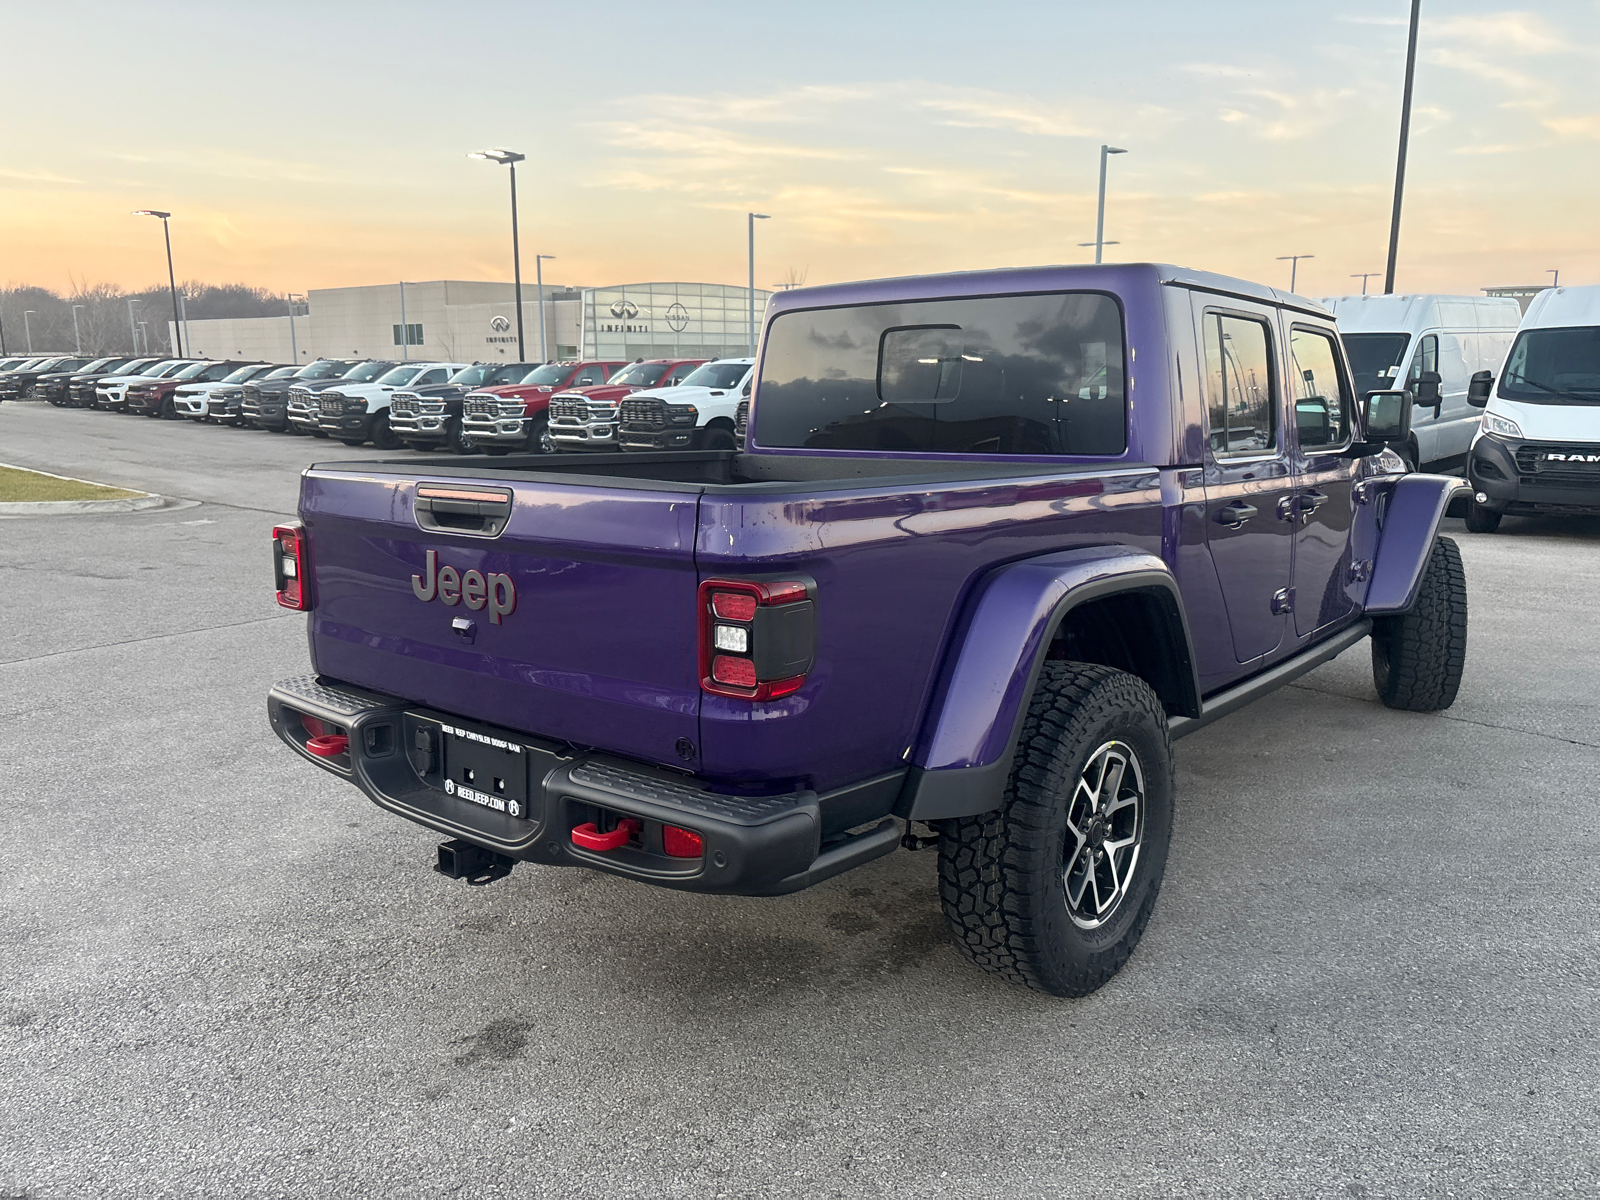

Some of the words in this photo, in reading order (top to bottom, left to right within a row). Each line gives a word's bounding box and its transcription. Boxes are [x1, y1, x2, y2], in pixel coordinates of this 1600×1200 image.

[601, 324, 648, 333] INFINITI
[486, 336, 517, 344] INFINITI
[1547, 453, 1600, 463] RAM
[411, 549, 517, 625] Jeep
[466, 731, 491, 745] CHRYSLER
[491, 738, 508, 749] DODGE
[508, 743, 521, 754] RAM
[457, 786, 505, 812] REEDJEEP.COM
